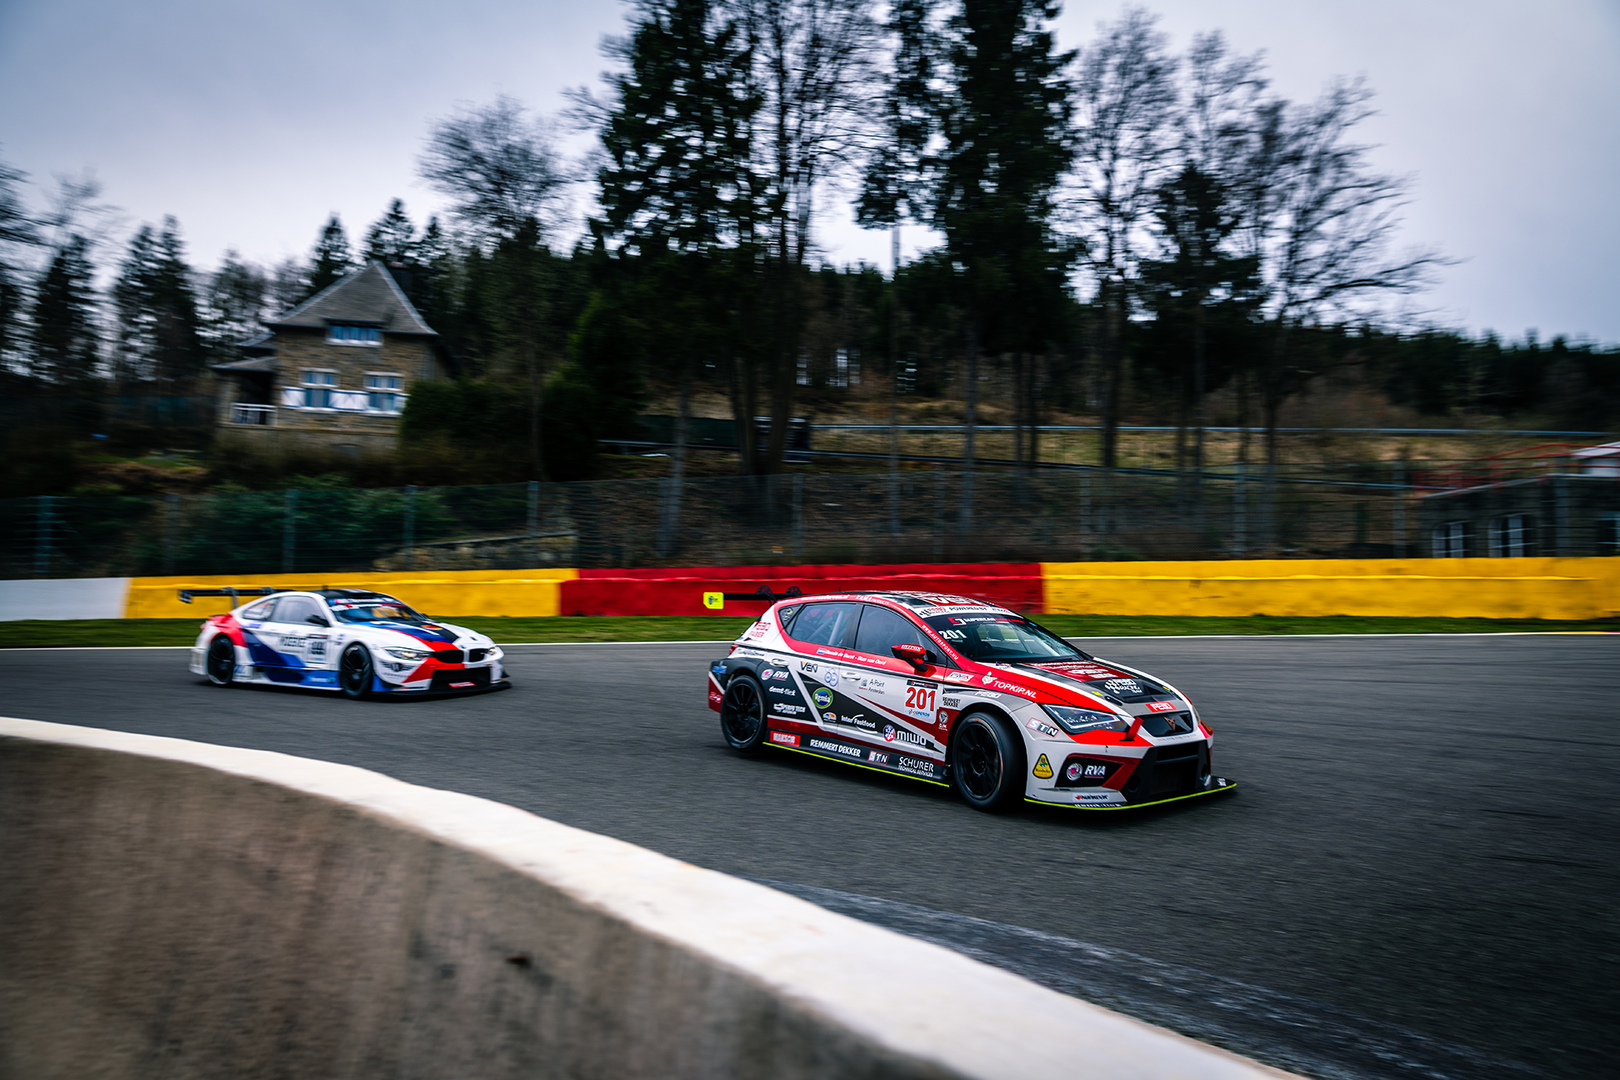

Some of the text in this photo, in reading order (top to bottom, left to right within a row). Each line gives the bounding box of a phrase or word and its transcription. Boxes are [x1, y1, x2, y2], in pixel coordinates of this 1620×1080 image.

[938, 629, 967, 640] 201
[993, 680, 1037, 699] TOPKIP.NL
[905, 686, 936, 712] 201
[1029, 719, 1058, 737] STN
[810, 738, 838, 752] REMMERT
[838, 743, 861, 758] DEKKER
[898, 756, 934, 773] SCHURER
[1084, 764, 1106, 776] RVA
